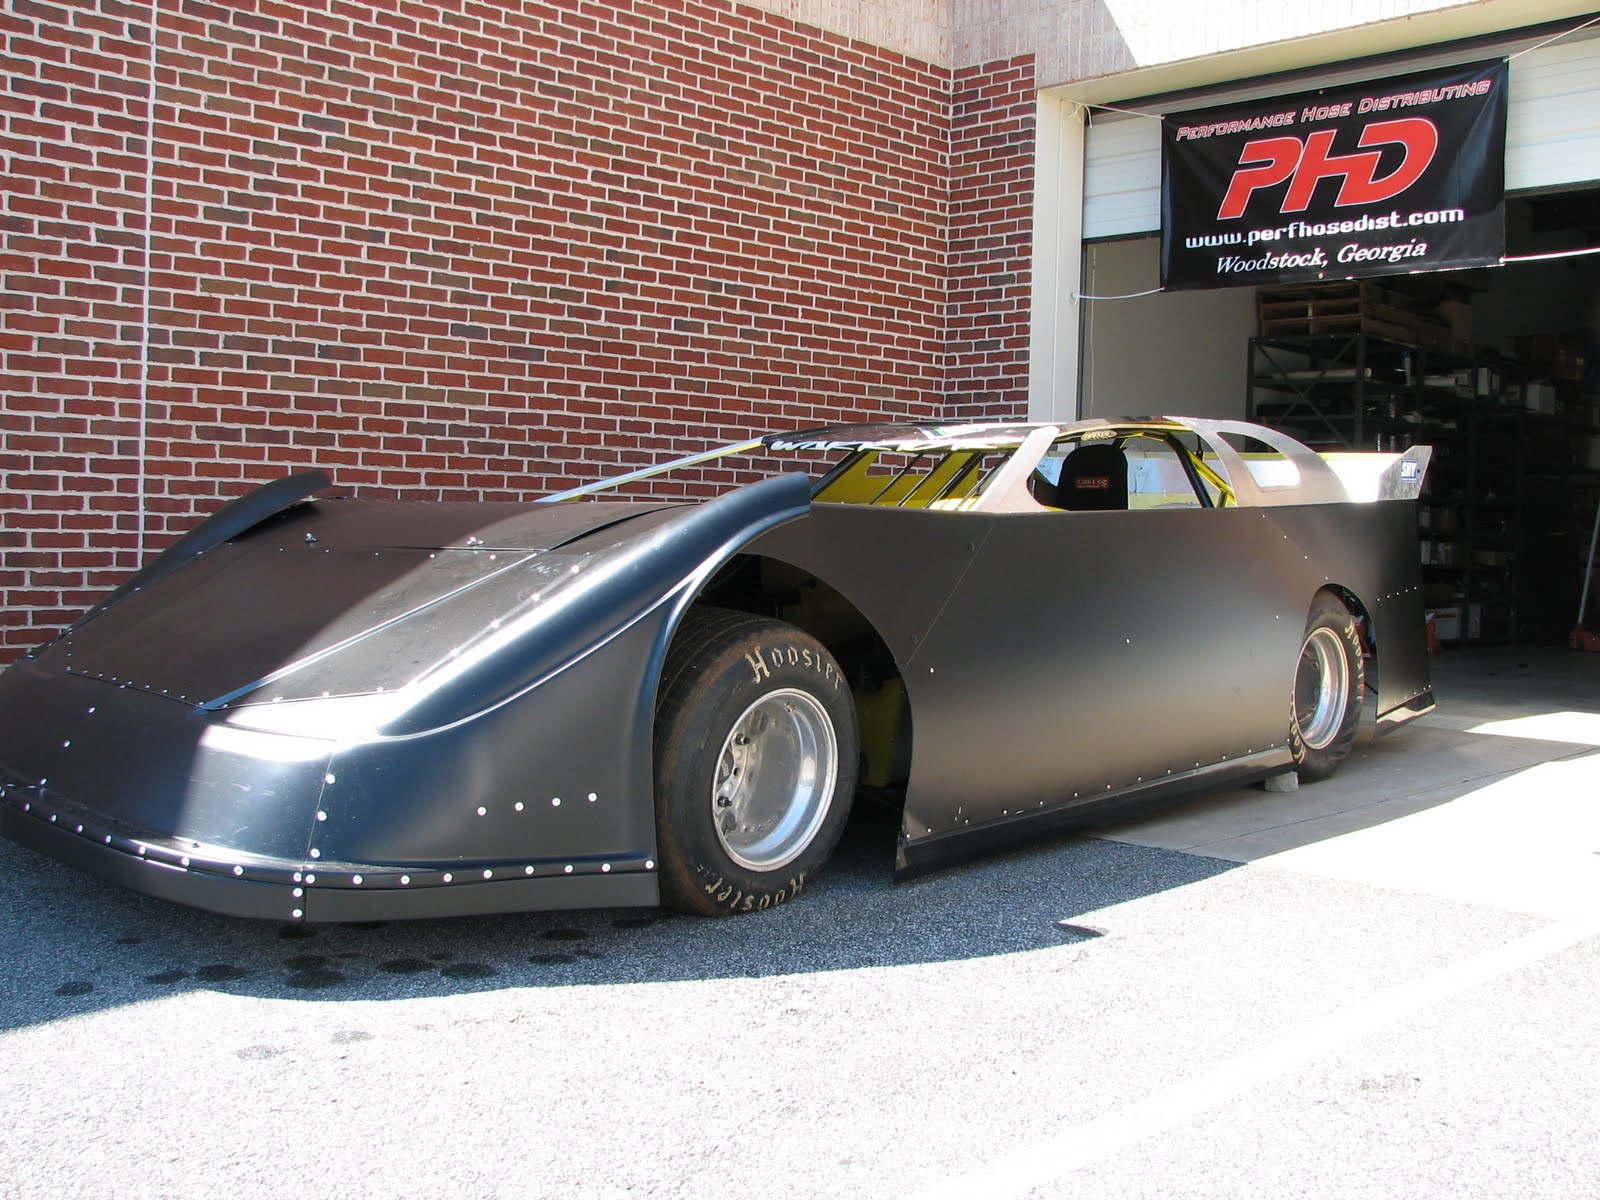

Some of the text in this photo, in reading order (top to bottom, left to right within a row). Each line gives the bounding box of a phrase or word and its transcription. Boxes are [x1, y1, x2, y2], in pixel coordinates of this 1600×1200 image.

[1176, 79, 1492, 142] PERFORMANCE HOSE DISTRIBUTING
[1216, 117, 1439, 221] PHD
[1185, 207, 1465, 249] www.perfhosedist.com
[1216, 238, 1428, 275] Woodstock, Georgia
[744, 645, 843, 690] Hoosier
